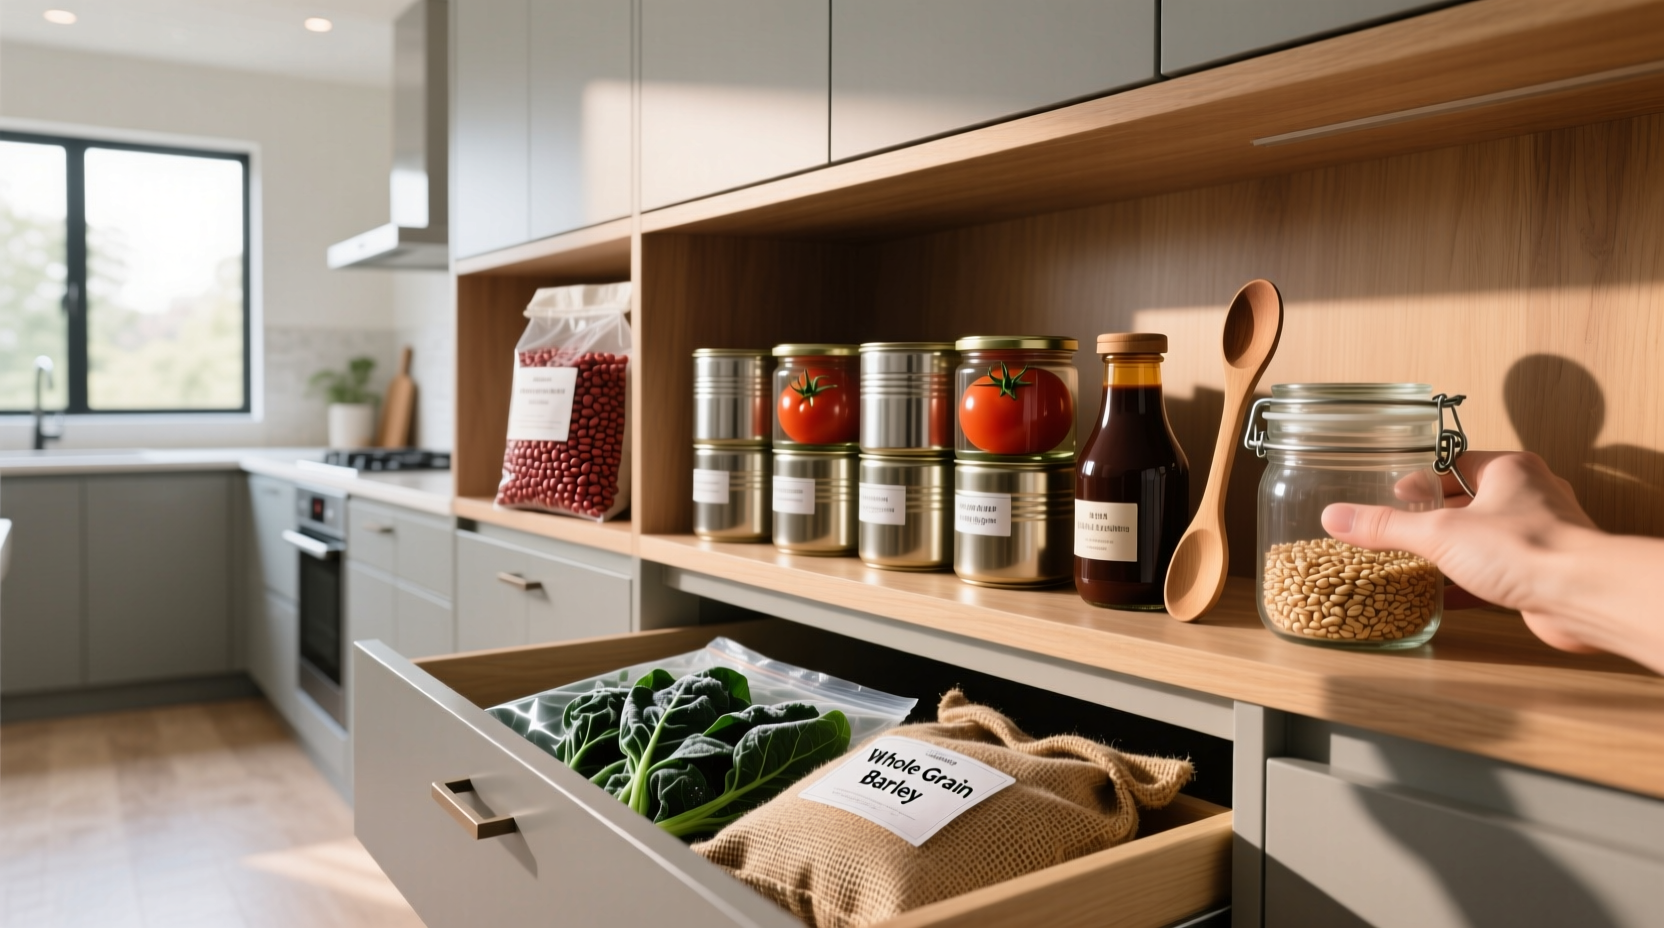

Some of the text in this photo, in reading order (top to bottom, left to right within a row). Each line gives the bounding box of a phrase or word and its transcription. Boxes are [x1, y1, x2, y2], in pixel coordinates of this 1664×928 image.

[859, 769, 923, 805] Barley
[867, 748, 921, 776] Whole
[922, 767, 974, 799] Grain
